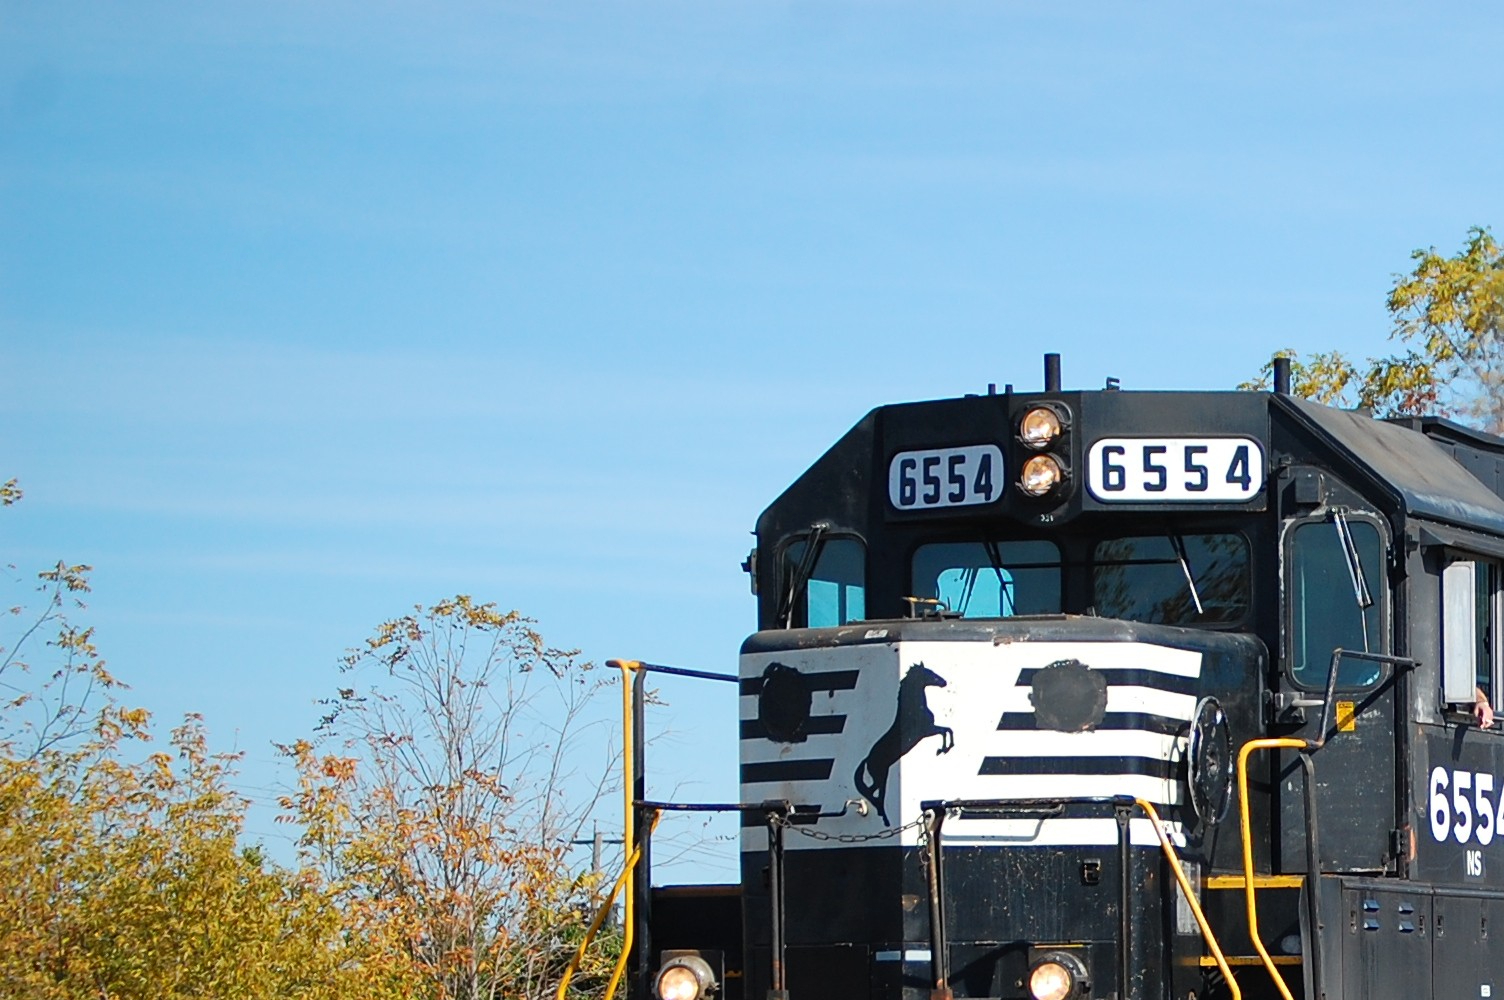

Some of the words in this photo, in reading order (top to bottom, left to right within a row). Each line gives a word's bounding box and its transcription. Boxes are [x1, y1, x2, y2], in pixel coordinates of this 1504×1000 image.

[900, 453, 993, 505] 6554
[1102, 445, 1252, 492] 6554
[1466, 849, 1482, 877] NS
